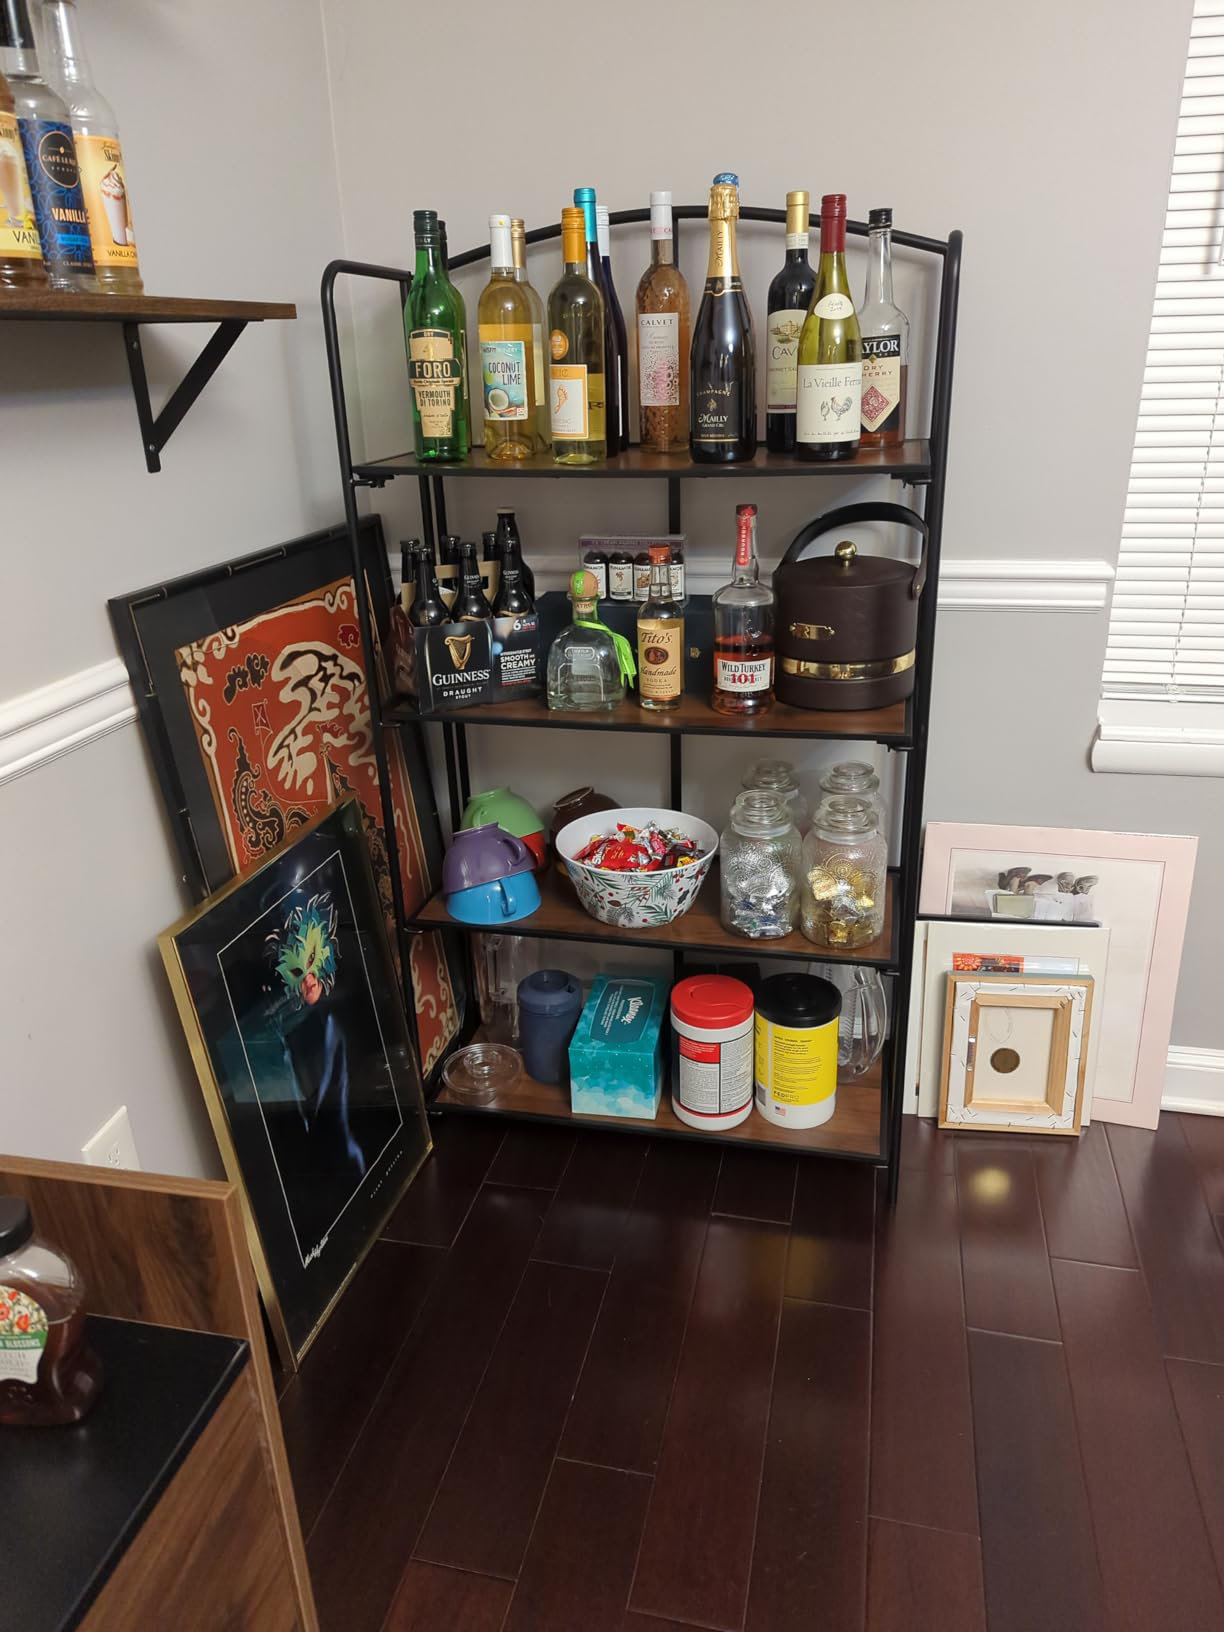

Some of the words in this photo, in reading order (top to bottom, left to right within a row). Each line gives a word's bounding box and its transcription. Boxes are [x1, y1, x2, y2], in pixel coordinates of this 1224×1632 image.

[640, 318, 674, 326] CALVET
[771, 345, 797, 360] CAV
[415, 361, 451, 379] FORO
[488, 361, 521, 374] COCONUT
[502, 373, 522, 386] LIME
[803, 377, 812, 389] La
[814, 376, 842, 388] Vieille
[418, 389, 451, 400] VERMOUTH
[420, 399, 427, 407] DI
[428, 399, 451, 407] TORINO
[513, 618, 522, 631] 6
[641, 631, 672, 644] Tito's
[500, 654, 529, 663] SMOOTH
[500, 658, 536, 670] CREAMY
[721, 660, 740, 673] WILD
[740, 663, 766, 673] TURKEY
[432, 669, 490, 686] GUINNESS
[730, 672, 756, 685] 101
[443, 686, 482, 697] DRAUGHT
